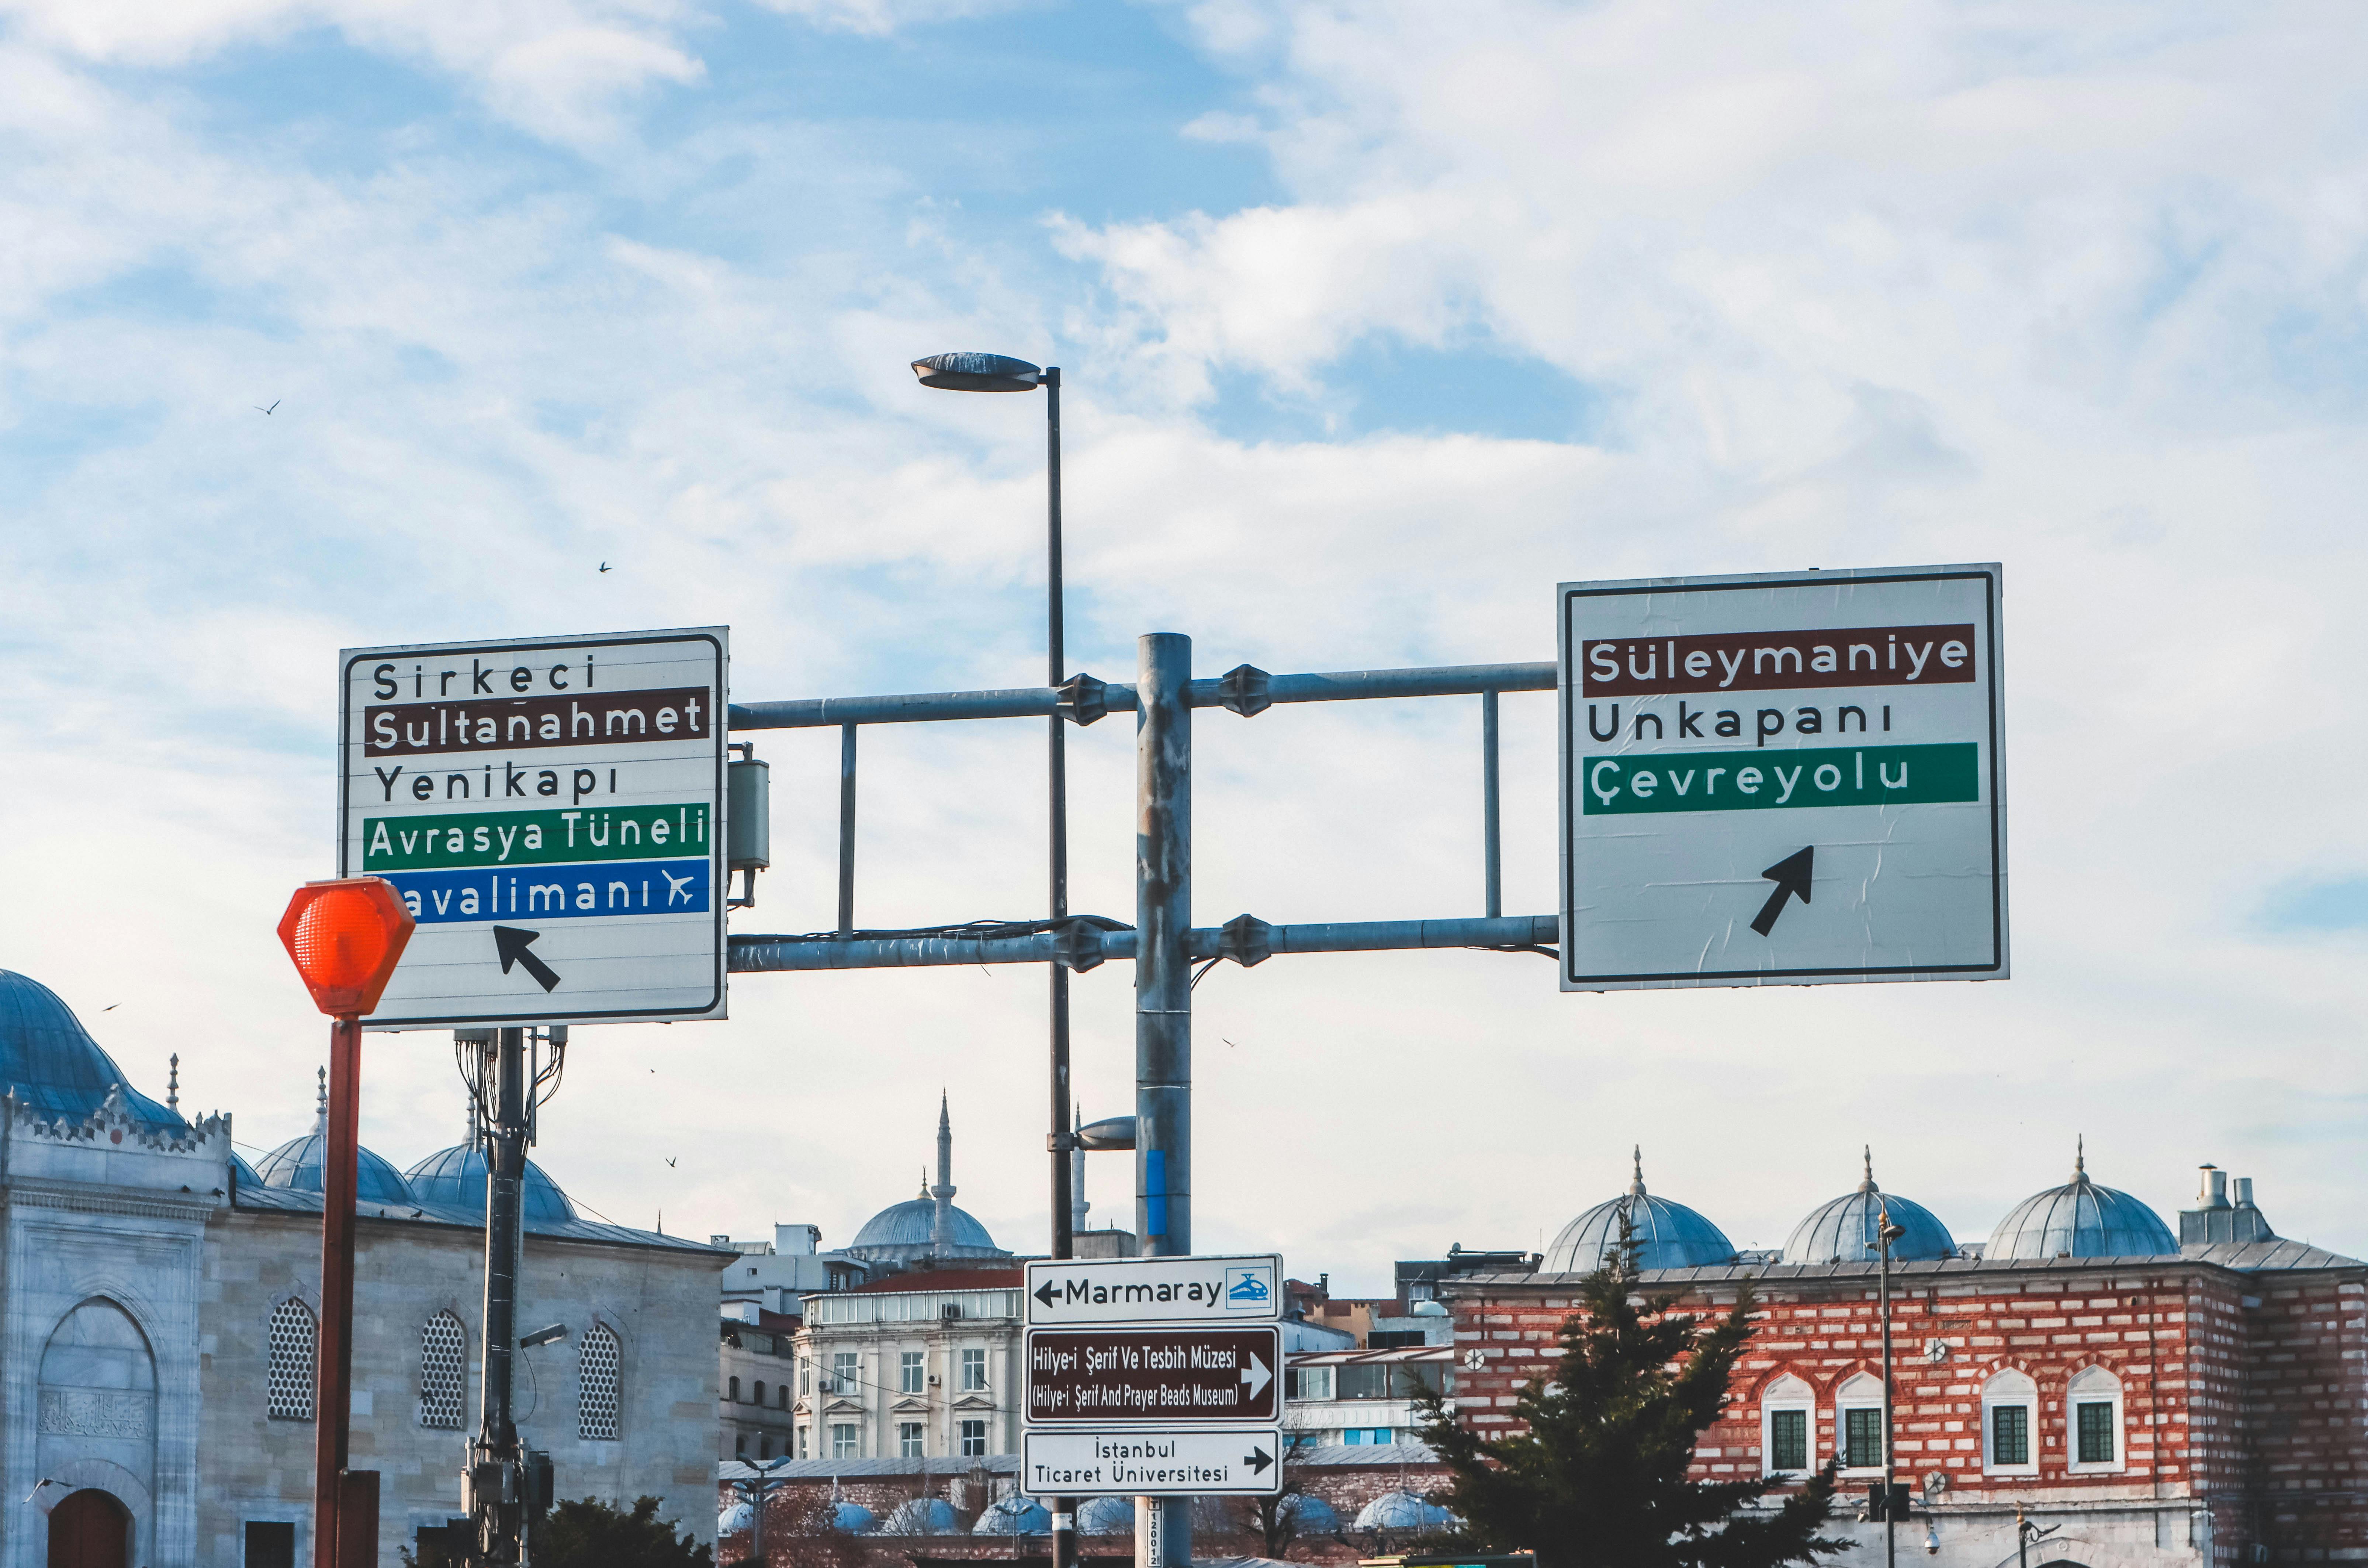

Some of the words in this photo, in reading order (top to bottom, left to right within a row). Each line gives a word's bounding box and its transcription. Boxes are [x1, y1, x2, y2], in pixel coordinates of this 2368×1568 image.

[374, 655, 593, 700] Sirkeci
[1590, 635, 1967, 687] Süleymaniye
[374, 698, 700, 749] Sultanahmet
[1589, 701, 1890, 747] Unkapanı
[374, 762, 616, 805] Yenikapı
[1591, 752, 1907, 805] Çevreyolu
[369, 822, 542, 861] Avrasya
[561, 808, 703, 847] Tüneli
[404, 876, 648, 917] avalimanı
[1066, 1279, 1222, 1308] Marmaray
[1034, 1346, 1077, 1376] Hilye-i
[1086, 1346, 1118, 1376] Şerif
[1121, 1346, 1139, 1369] Ve
[1142, 1345, 1186, 1369] Tesbih
[1191, 1345, 1236, 1368] Müzesi
[1033, 1384, 1069, 1412] (Hilye-i
[1075, 1384, 1098, 1412] Şerif
[1101, 1384, 1121, 1406] And
[1124, 1384, 1157, 1411] Prayer
[1161, 1383, 1190, 1406] Beads
[1193, 1383, 1238, 1406] Museum)
[1096, 1436, 1174, 1458] İstanbul
[1035, 1465, 1101, 1482] Ticaret
[1113, 1460, 1227, 1482] Üniversitesi
